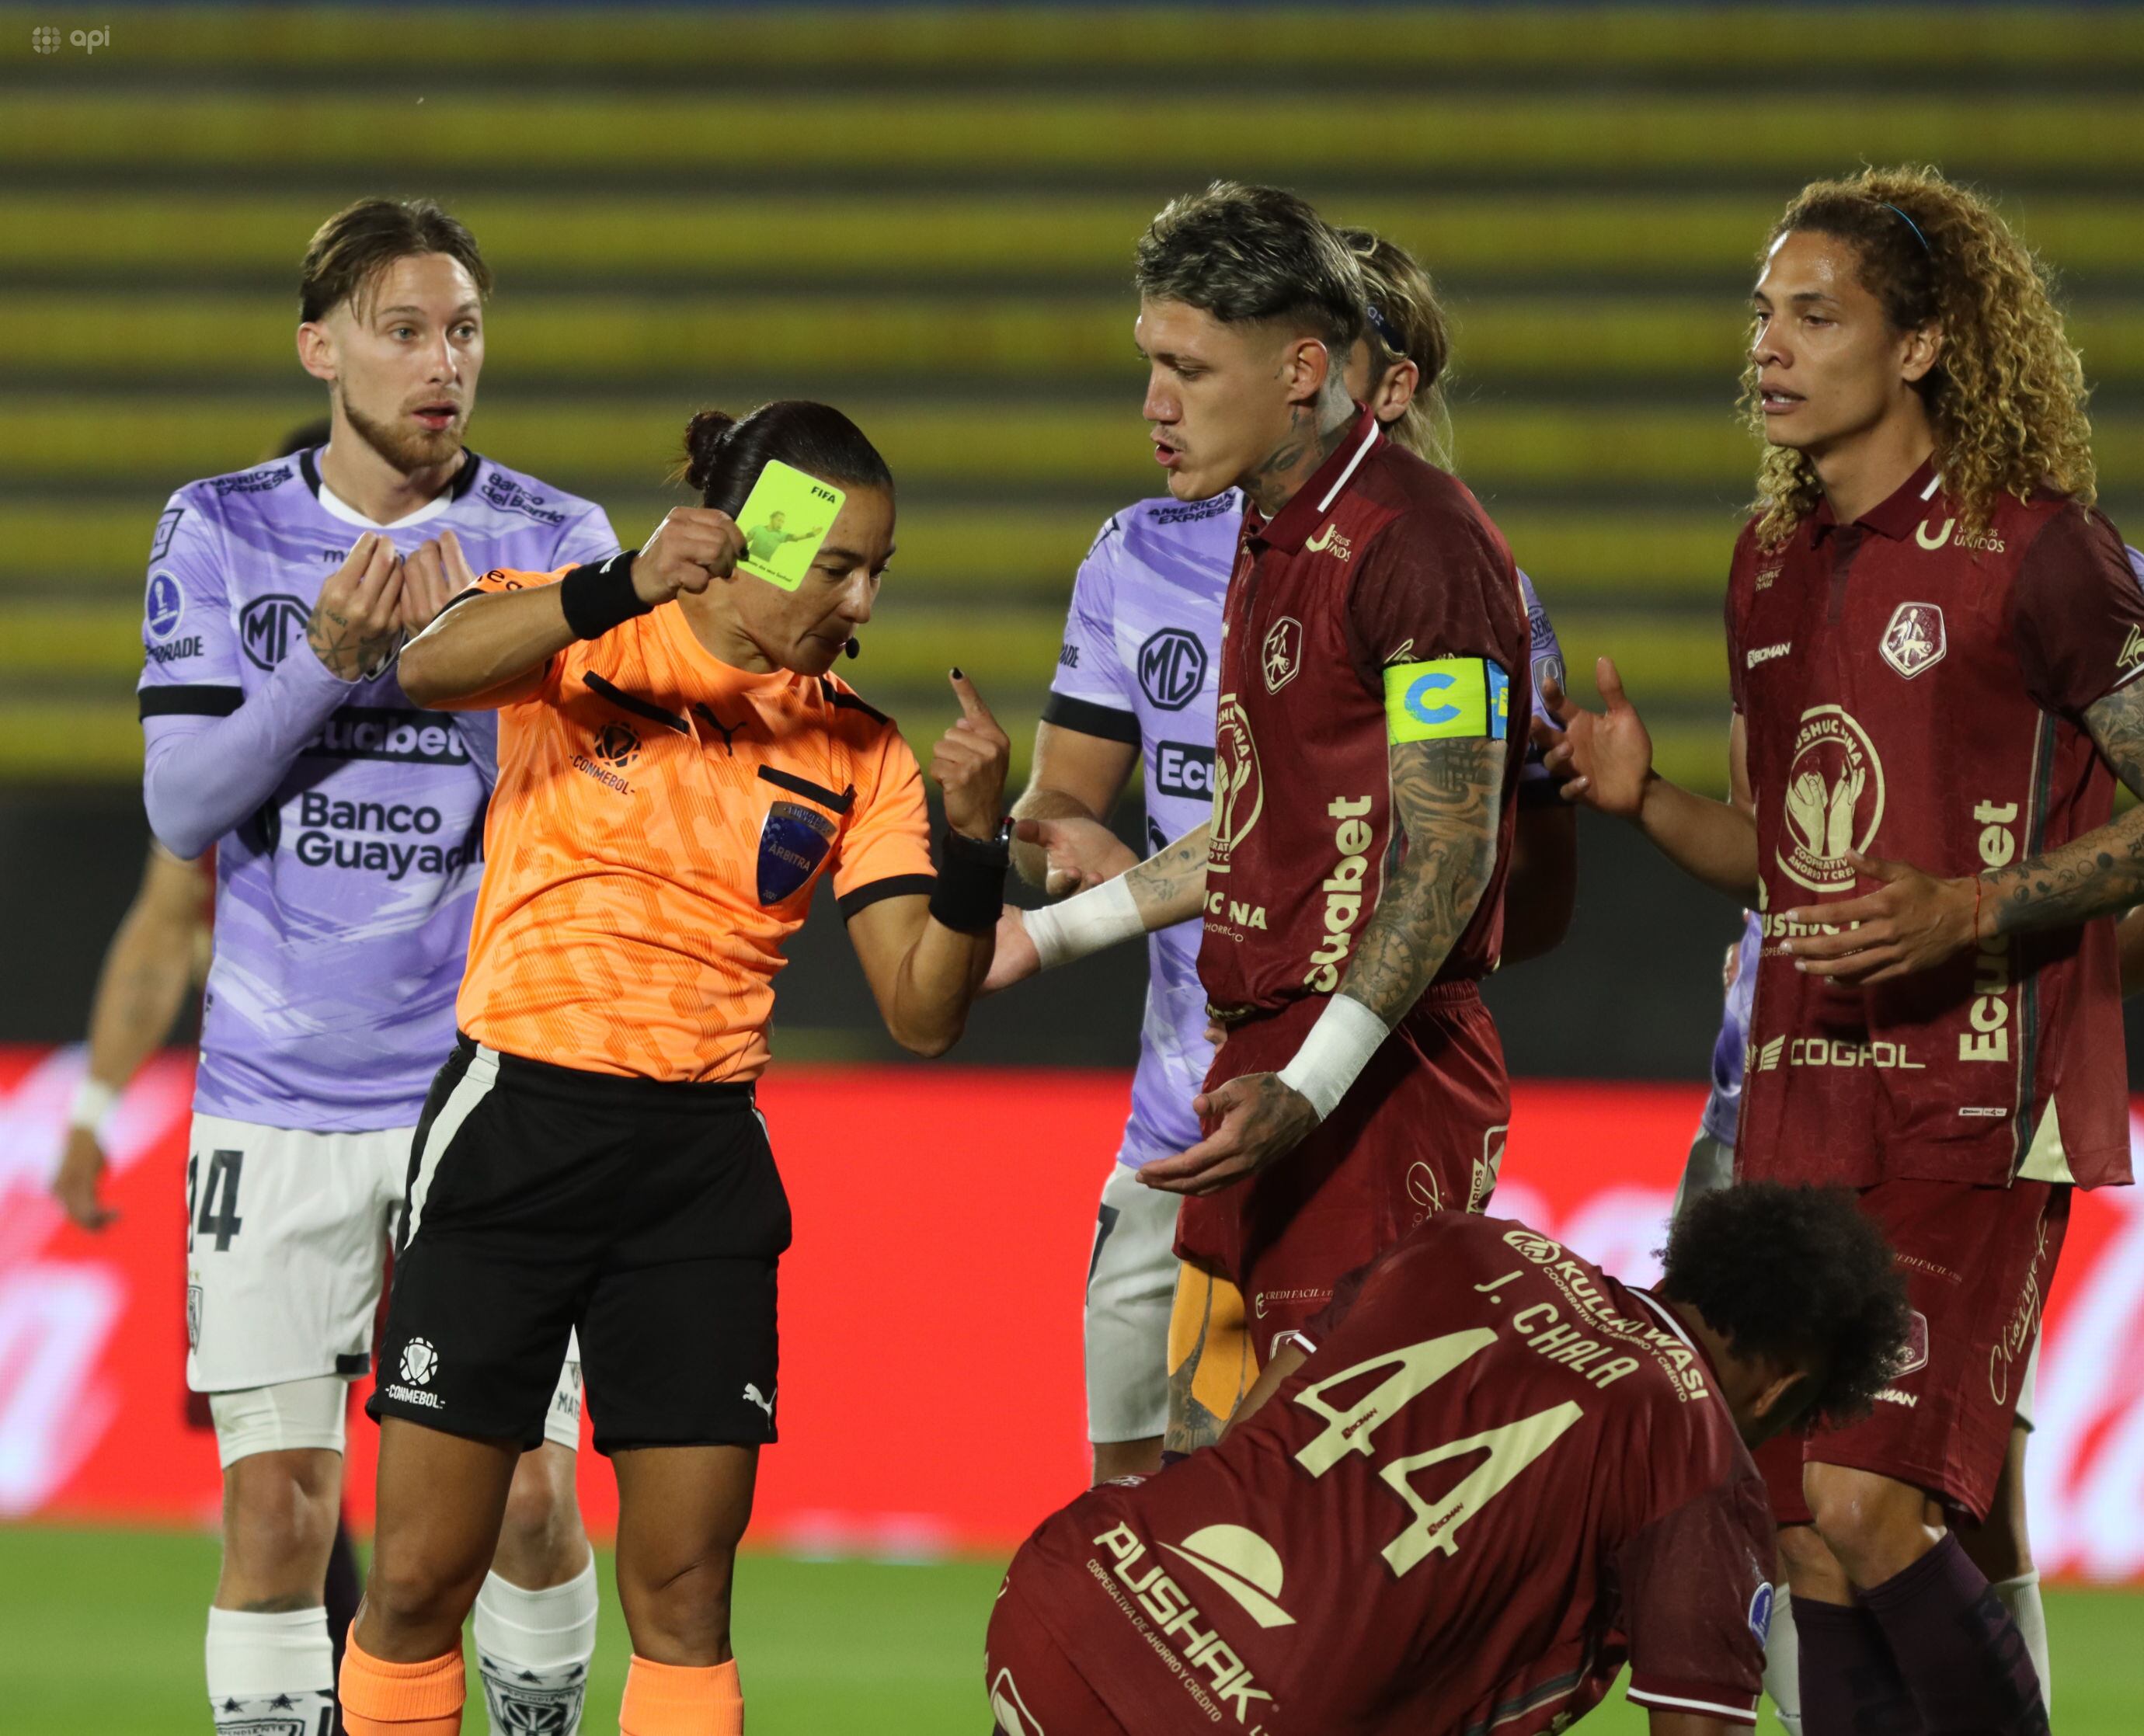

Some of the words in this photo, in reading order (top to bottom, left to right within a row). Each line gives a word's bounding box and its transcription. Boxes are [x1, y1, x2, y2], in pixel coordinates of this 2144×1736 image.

[481, 484, 507, 506] del
[510, 493, 566, 524] Barrio
[488, 471, 545, 506] Banco
[811, 486, 837, 504] FIFA
[1147, 492, 1236, 516] AMERICAN
[1158, 499, 1234, 524] EXPRESS
[1143, 637, 1200, 702] MG
[1404, 673, 1462, 725] C
[306, 719, 465, 757] uabet
[300, 791, 442, 835] Banco
[188, 1149, 244, 1254] 14
[1542, 1265, 1598, 1327] COOPERATIVA
[1473, 1269, 1525, 1305] J.
[1512, 1302, 1640, 1390] CHALA
[1643, 1327, 1710, 1400] WASI
[1293, 1327, 1584, 1578] 44
[1086, 1557, 1136, 1620] COOPERATIVA
[1132, 1614, 1148, 1633] DE
[1143, 1630, 1182, 1674] AHORRO
[1178, 1667, 1187, 1680] Y
[1091, 1520, 1274, 1725] PUSHAK
